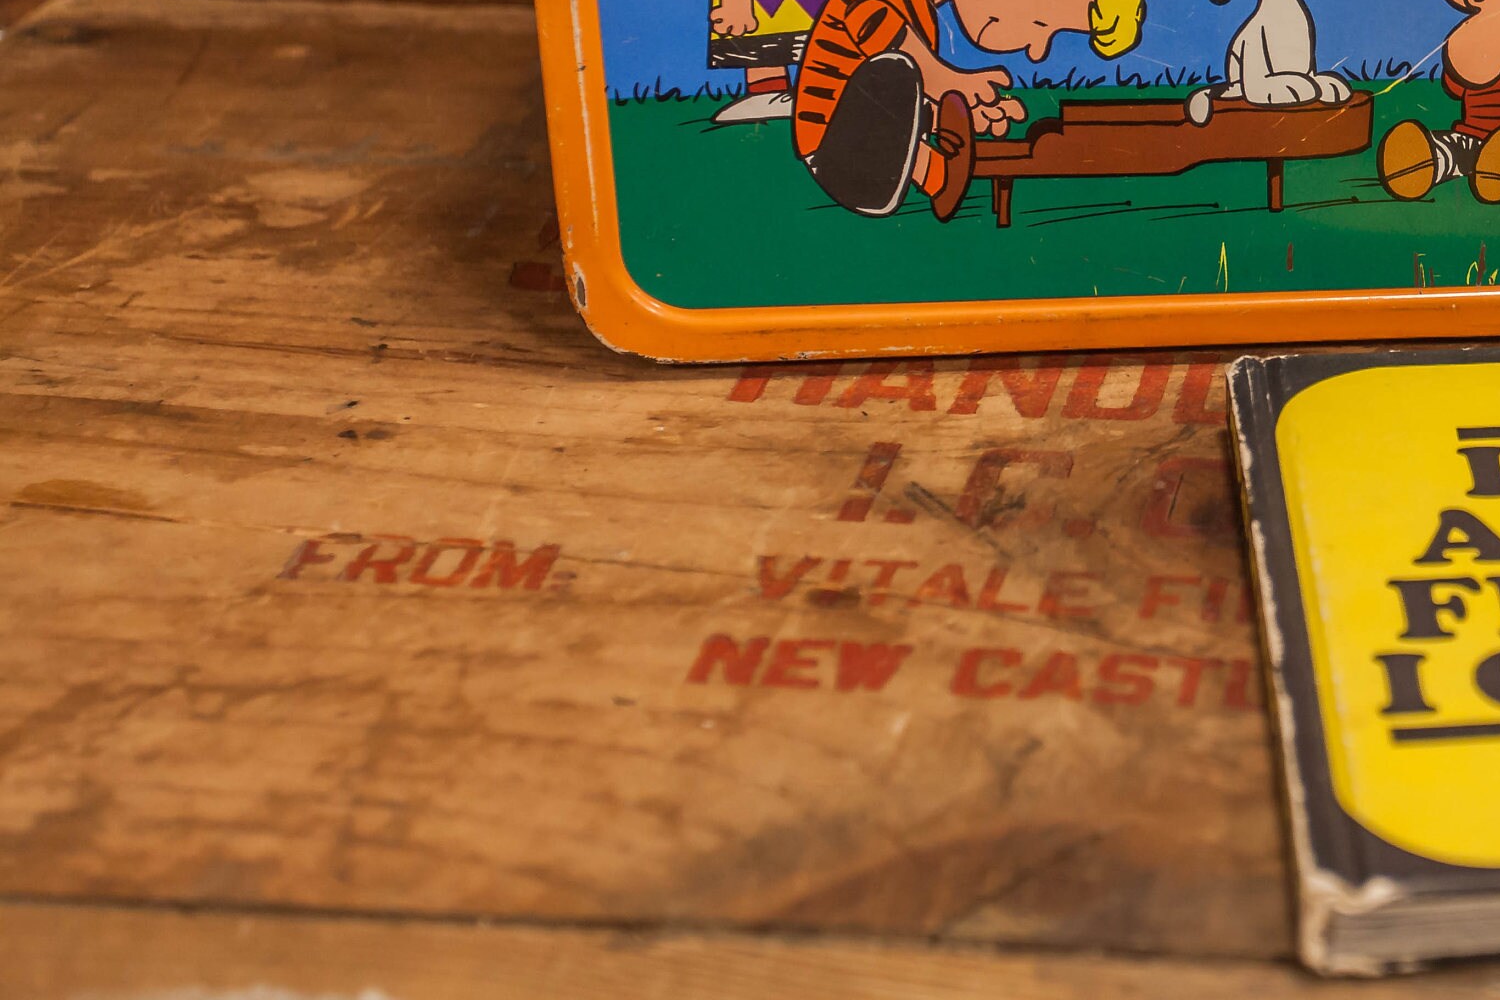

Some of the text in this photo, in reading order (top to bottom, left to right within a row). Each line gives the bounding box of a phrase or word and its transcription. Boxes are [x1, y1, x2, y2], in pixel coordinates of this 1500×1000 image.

[686, 634, 1264, 709] NEW CASTL
[1377, 653, 1434, 715] I
